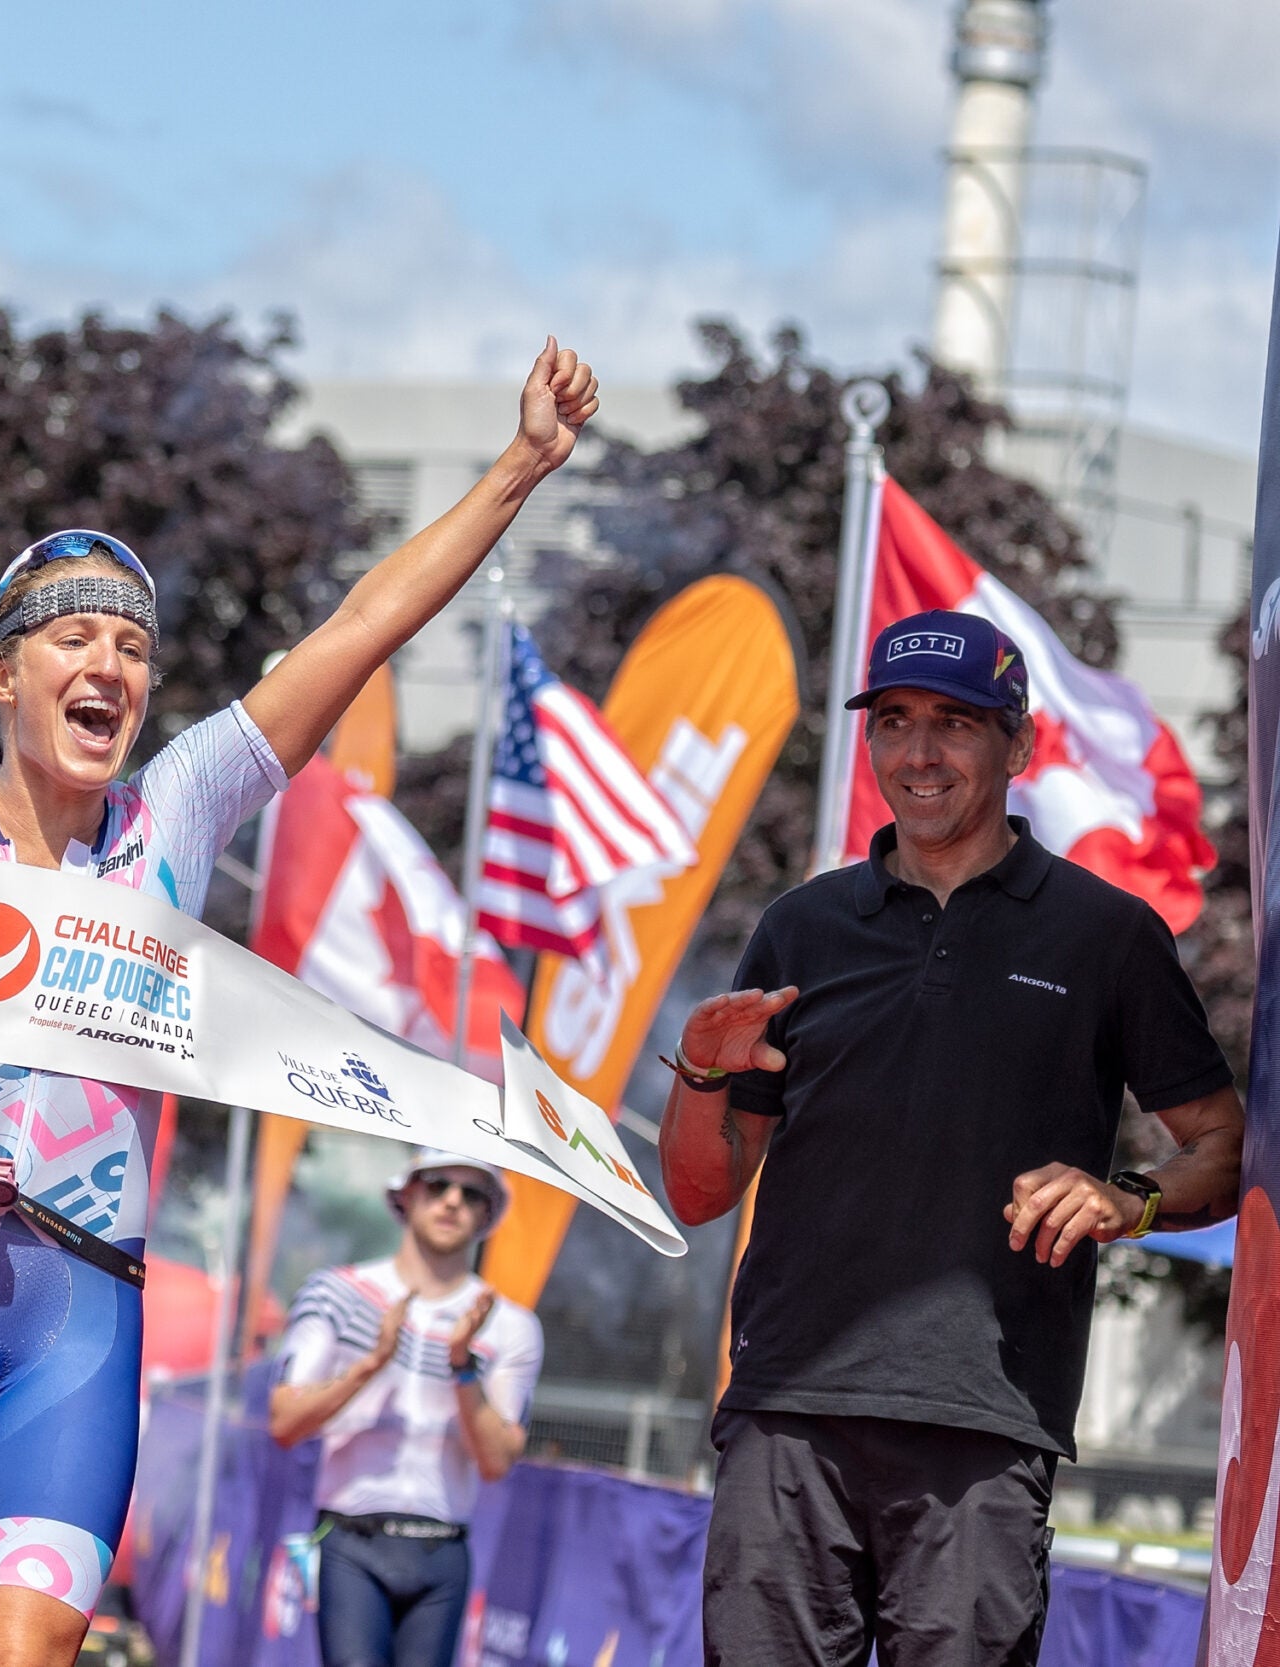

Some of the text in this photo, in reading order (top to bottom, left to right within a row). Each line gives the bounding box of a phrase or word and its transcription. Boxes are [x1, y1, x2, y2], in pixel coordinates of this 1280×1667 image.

[893, 637, 957, 654] ROTH
[55, 915, 188, 979] CHALLENGE
[40, 946, 104, 994] CAP
[1008, 973, 1067, 995] ARGON 18
[29, 1016, 77, 1033] Propulsé par
[34, 995, 194, 1043] QUÉBEC CANADA
[76, 1027, 175, 1054] ARGON 18
[278, 1051, 342, 1084] VILLE DE
[287, 1072, 412, 1128] QUÉBEC
[36, 1211, 82, 1245] blueseventy
